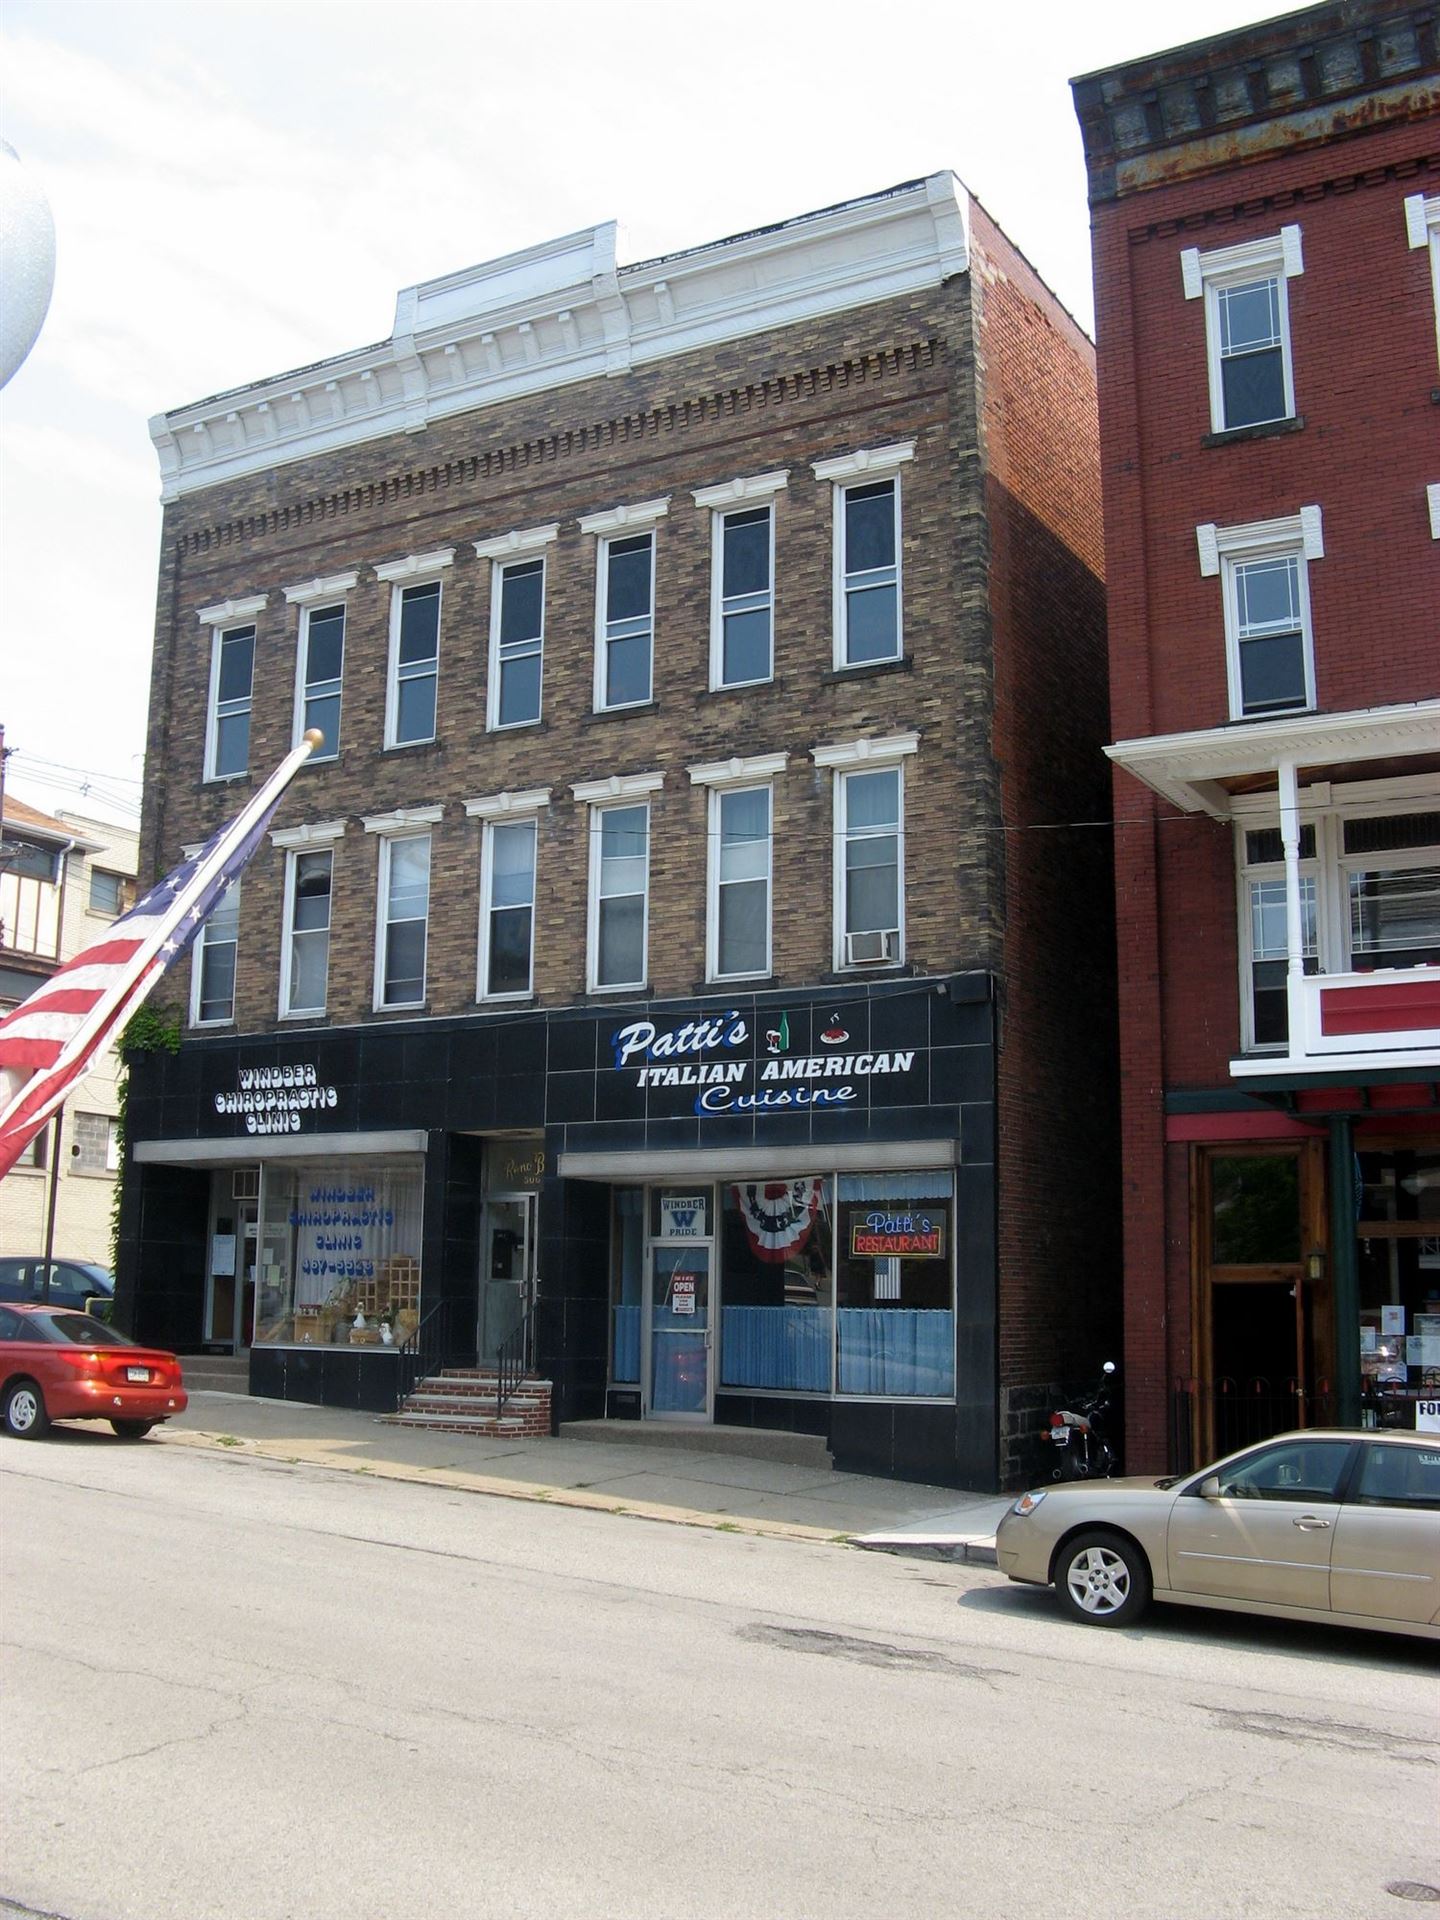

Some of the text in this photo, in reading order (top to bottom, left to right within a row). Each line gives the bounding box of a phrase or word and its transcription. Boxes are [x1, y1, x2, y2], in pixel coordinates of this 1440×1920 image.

[612, 1010, 749, 1070] Patti's
[239, 1064, 317, 1090] WINDBER
[636, 1051, 916, 1088] ITALIAN AMERICAN
[215, 1086, 338, 1114] CHIROPRACTIC
[696, 1085, 858, 1115] Cuisine
[245, 1110, 301, 1134] CLINIC
[662, 1198, 705, 1211] WINDBER
[670, 1210, 698, 1228] W
[866, 1212, 931, 1234] Patti's
[669, 1228, 697, 1237] PRIDE
[316, 1235, 363, 1251] CLINIC
[856, 1235, 938, 1252] RESTAURANT
[673, 1282, 695, 1292] OPEN
[1419, 1402, 1440, 1416] FO
